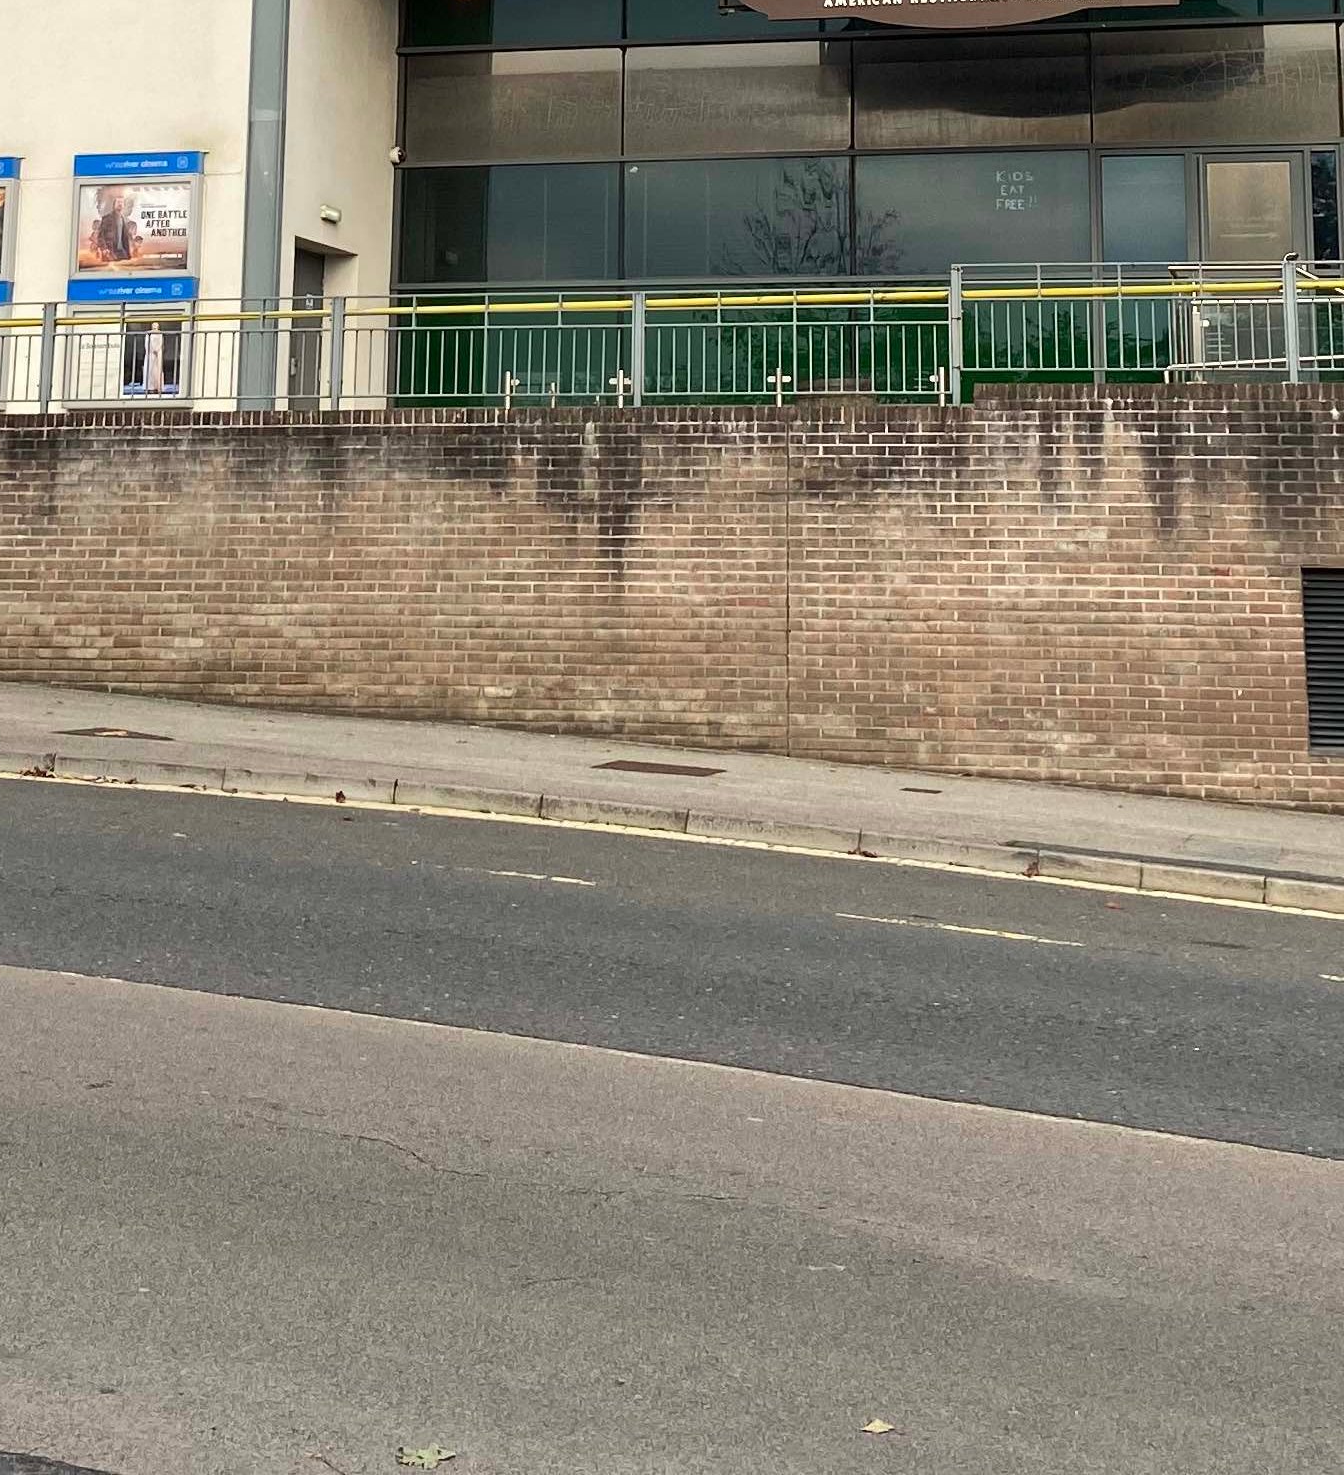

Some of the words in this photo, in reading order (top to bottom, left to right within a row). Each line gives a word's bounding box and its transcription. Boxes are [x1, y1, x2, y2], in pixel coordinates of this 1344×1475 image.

[995, 170, 1034, 183] KIDS
[1000, 185, 1025, 196] EAT
[140, 210, 156, 219] ONE
[157, 210, 188, 219] BATTLE
[145, 219, 170, 228] AFTER
[150, 228, 187, 237] ANOTHER
